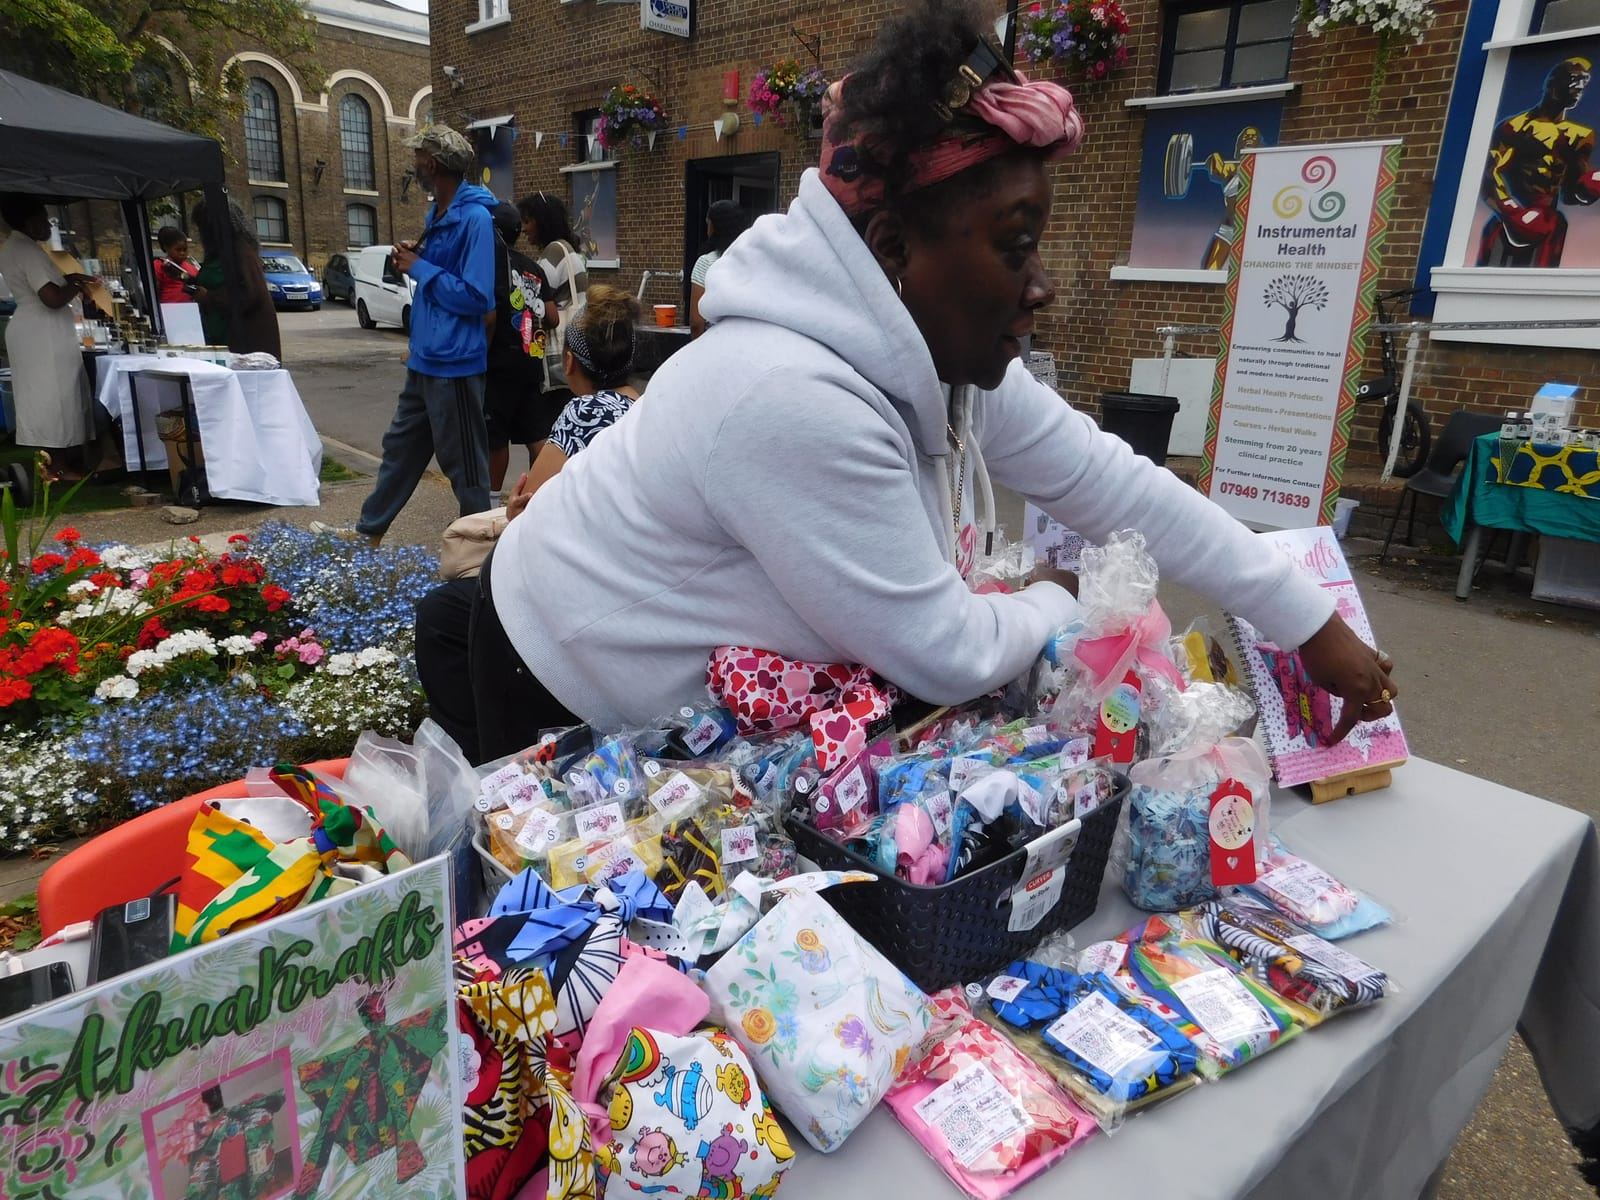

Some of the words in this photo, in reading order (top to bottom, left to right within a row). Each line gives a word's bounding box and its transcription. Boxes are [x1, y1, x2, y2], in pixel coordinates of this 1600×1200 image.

[1257, 224, 1357, 238] Instrumental
[1277, 243, 1326, 256] Health
[1243, 260, 1292, 269] CHANGING
[1295, 261, 1313, 270] THE
[1315, 262, 1360, 270] MINDSET
[1232, 343, 1272, 353] Empowering
[1273, 347, 1315, 356] communities
[1238, 357, 1267, 366] naturally
[1268, 359, 1294, 368] through
[1295, 361, 1330, 370] traditional
[1249, 370, 1274, 378] modern
[1296, 375, 1329, 383] practices
[1237, 386, 1262, 395] Herbal
[1262, 388, 1288, 398] Health
[1288, 391, 1324, 402] Products
[1224, 401, 1273, 414] Consultations
[1279, 408, 1333, 421] Presentations
[1233, 419, 1262, 430] Courses
[1267, 424, 1293, 434] Herbal
[1294, 427, 1318, 437] Walks
[1224, 436, 1264, 449] Stemming
[1266, 442, 1285, 451] from
[1286, 445, 1297, 453] 20
[1299, 447, 1323, 456] years
[1238, 450, 1267, 461] clinical
[1268, 455, 1304, 467] practice
[1226, 468, 1251, 477] Further
[1252, 472, 1291, 484] Information
[1292, 479, 1321, 489] Contact
[1220, 481, 1259, 500] 07949
[1261, 489, 1311, 509] 713639
[647, 766, 658, 775] L
[618, 782, 626, 792] S
[479, 799, 488, 809] S
[547, 830, 556, 841] S
[575, 856, 585, 869] S
